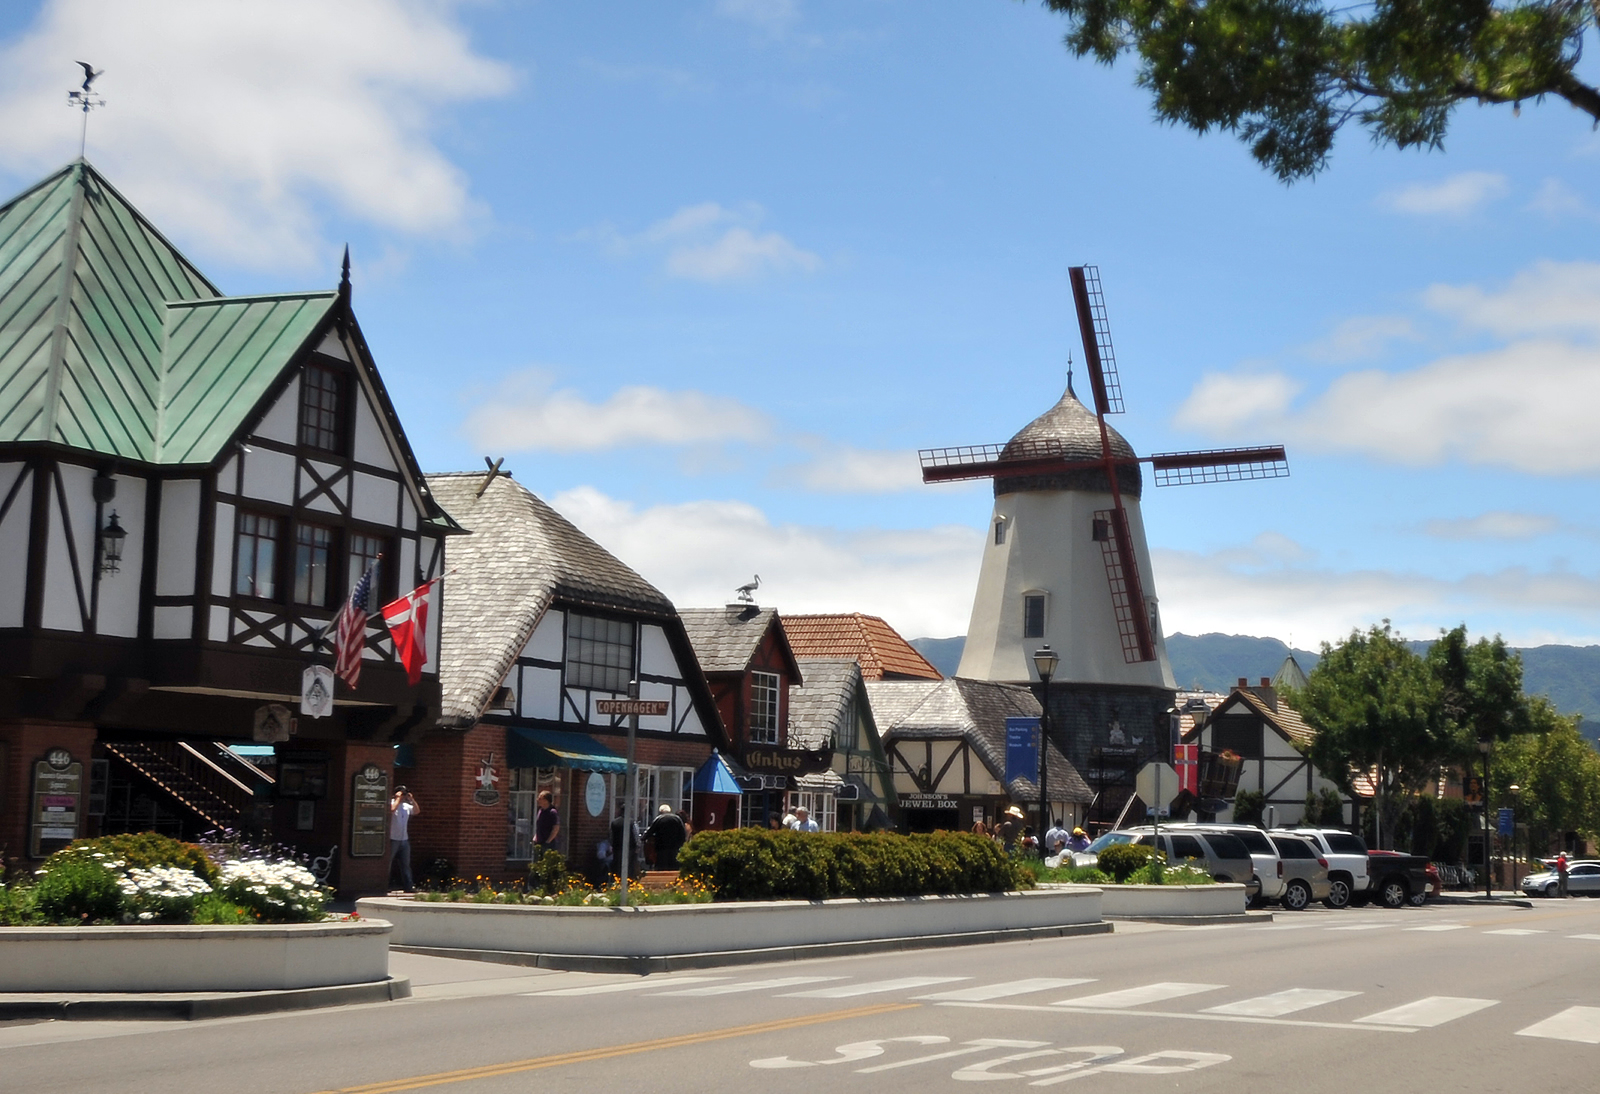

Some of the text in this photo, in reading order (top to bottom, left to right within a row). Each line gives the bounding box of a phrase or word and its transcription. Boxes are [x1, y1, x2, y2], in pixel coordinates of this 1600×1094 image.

[598, 701, 657, 713] COPENHAGEN
[49, 751, 70, 765] 446
[899, 800, 958, 809] JEWEL BOX
[749, 1035, 1233, 1086] STOP
